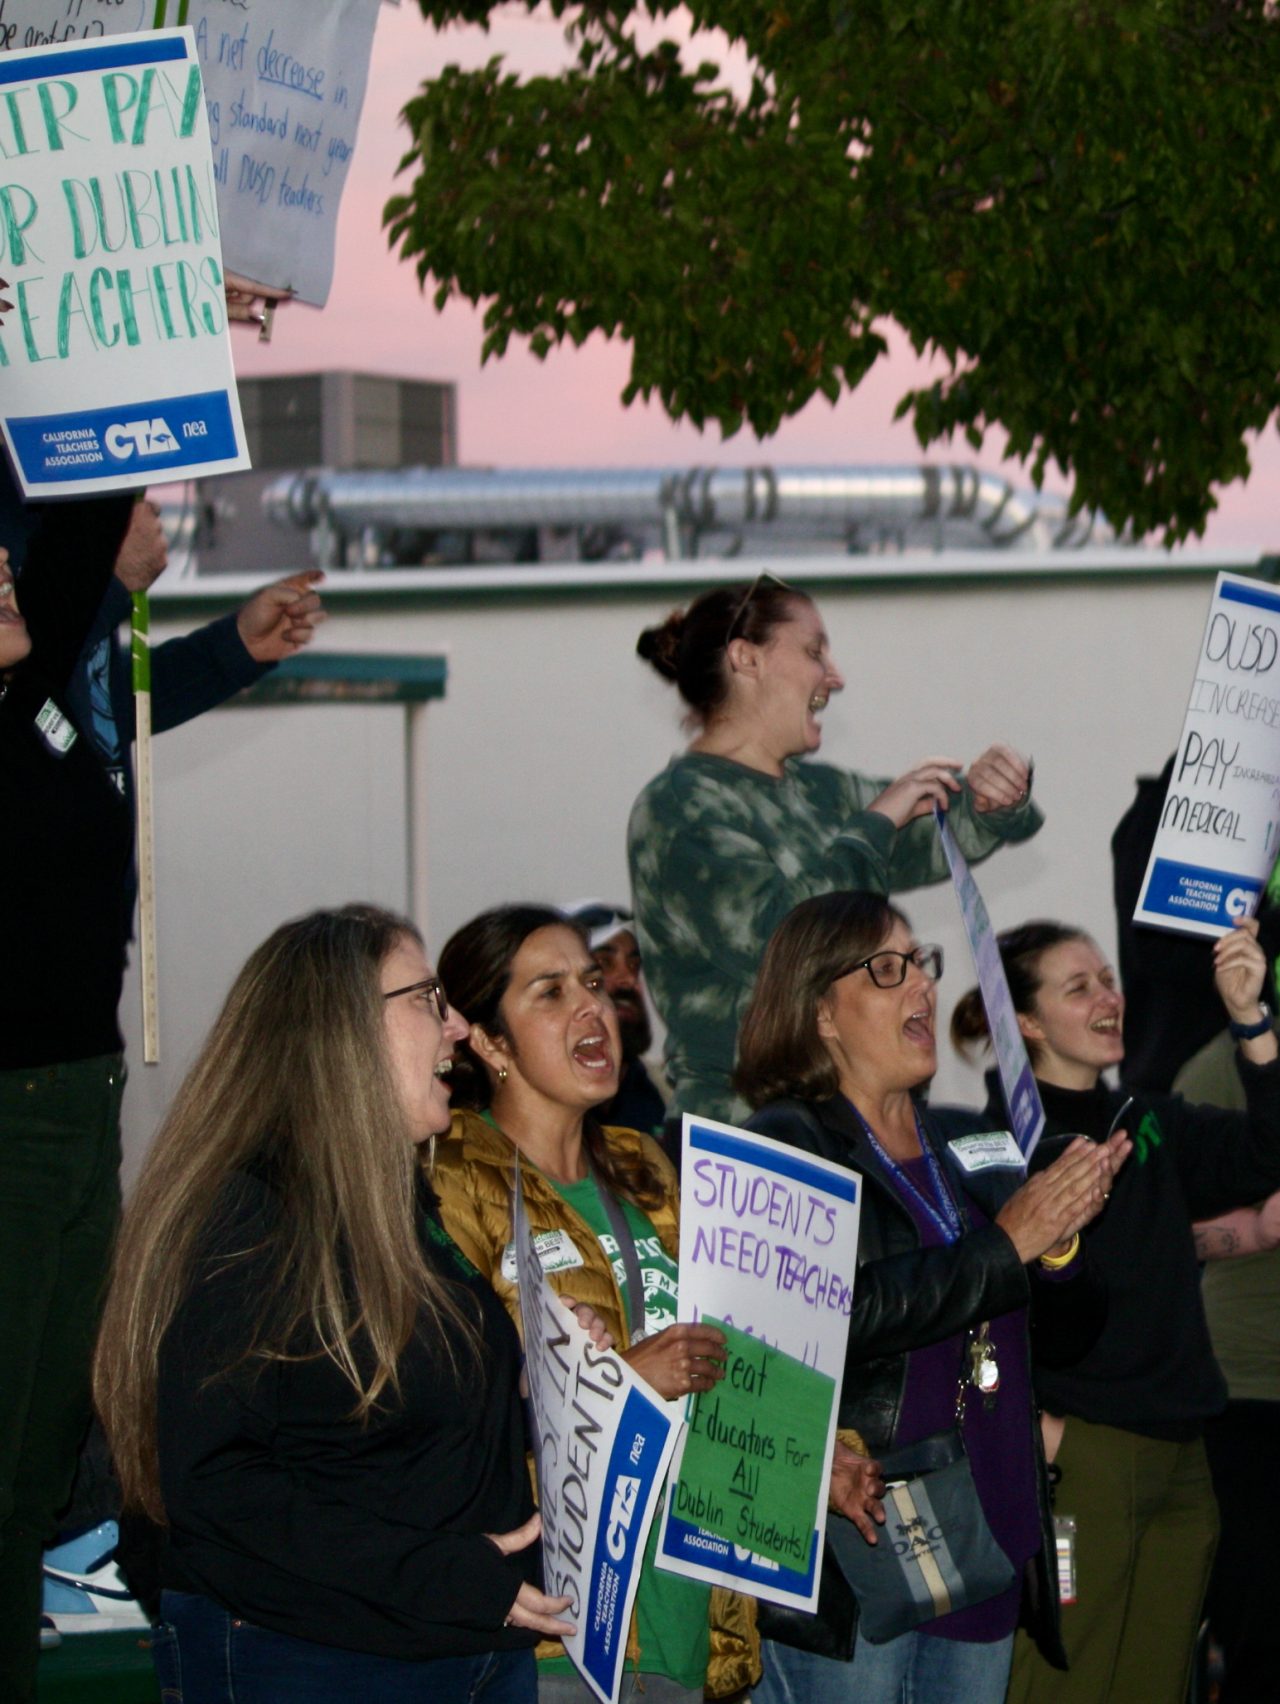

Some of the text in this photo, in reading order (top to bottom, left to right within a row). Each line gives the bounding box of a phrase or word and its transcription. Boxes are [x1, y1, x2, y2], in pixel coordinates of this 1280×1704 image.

[219, 22, 248, 71] net
[101, 63, 200, 146] PAY
[230, 89, 289, 140] standard
[294, 118, 324, 152] next
[61, 163, 217, 260] DUBLIN
[42, 428, 97, 444] CALIFORNIA
[45, 451, 104, 467] ASSOCIATION
[55, 439, 100, 454] TEACHERS
[104, 416, 209, 460] CTA nea
[1178, 730, 1240, 791] PAY
[1161, 794, 1247, 843] MEDICAL
[1168, 894, 1219, 913] ASSOCIATION
[1179, 876, 1223, 894] CALIFORNIA
[1185, 888, 1221, 903] TEACHERS
[693, 1158, 837, 1246] STUDENTS
[691, 1225, 770, 1279] NEED
[732, 1456, 760, 1495] All
[785, 1436, 811, 1467] For
[556, 1341, 624, 1620] STUDENTS
[606, 1433, 646, 1562] CTA nea
[676, 1478, 724, 1527] Dublin
[736, 1503, 813, 1561] Students!
[683, 1533, 729, 1556] ASSOCIATION
[593, 1560, 608, 1632] CALIFORNIA
[600, 1567, 614, 1625] TEACHERS
[603, 1573, 620, 1656] ASSOCIATION
